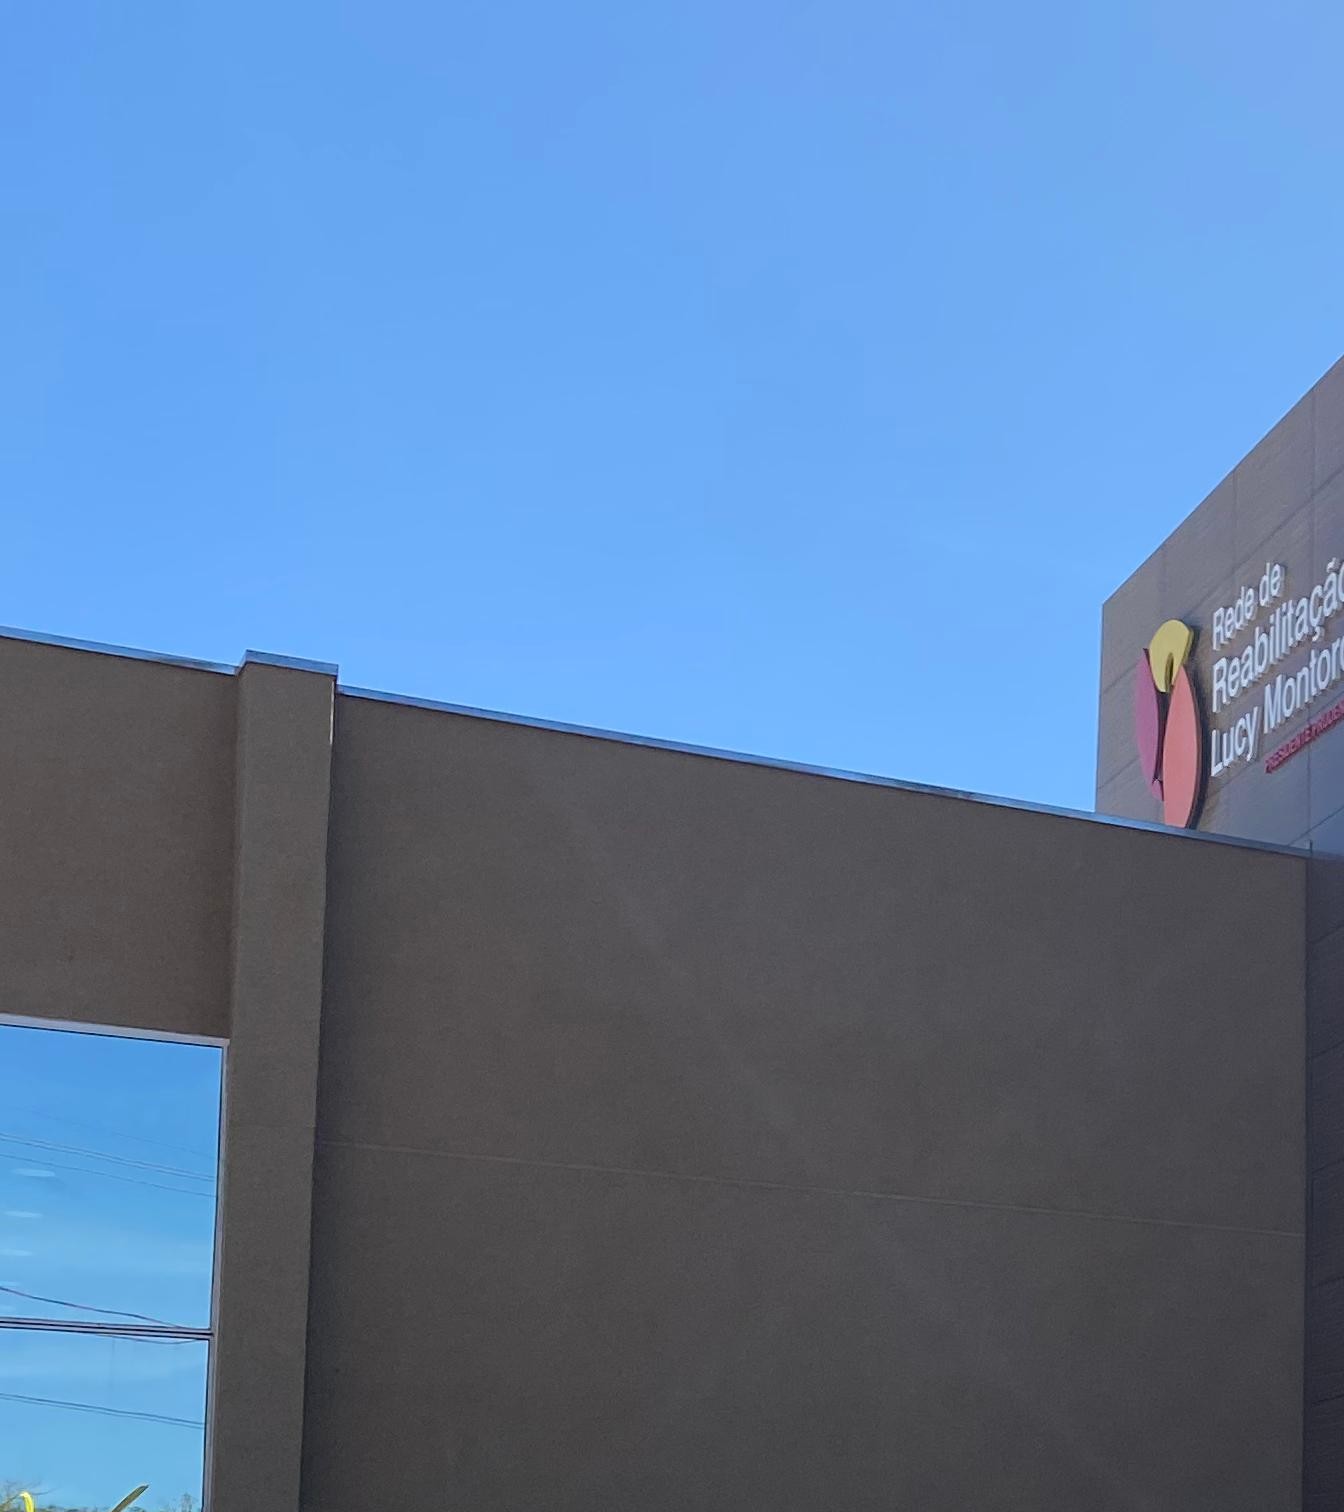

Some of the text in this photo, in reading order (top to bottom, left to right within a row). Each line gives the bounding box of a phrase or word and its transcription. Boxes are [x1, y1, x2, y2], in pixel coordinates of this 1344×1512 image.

[1212, 562, 1285, 650] Rede de
[1210, 704, 1259, 777] Lucy
